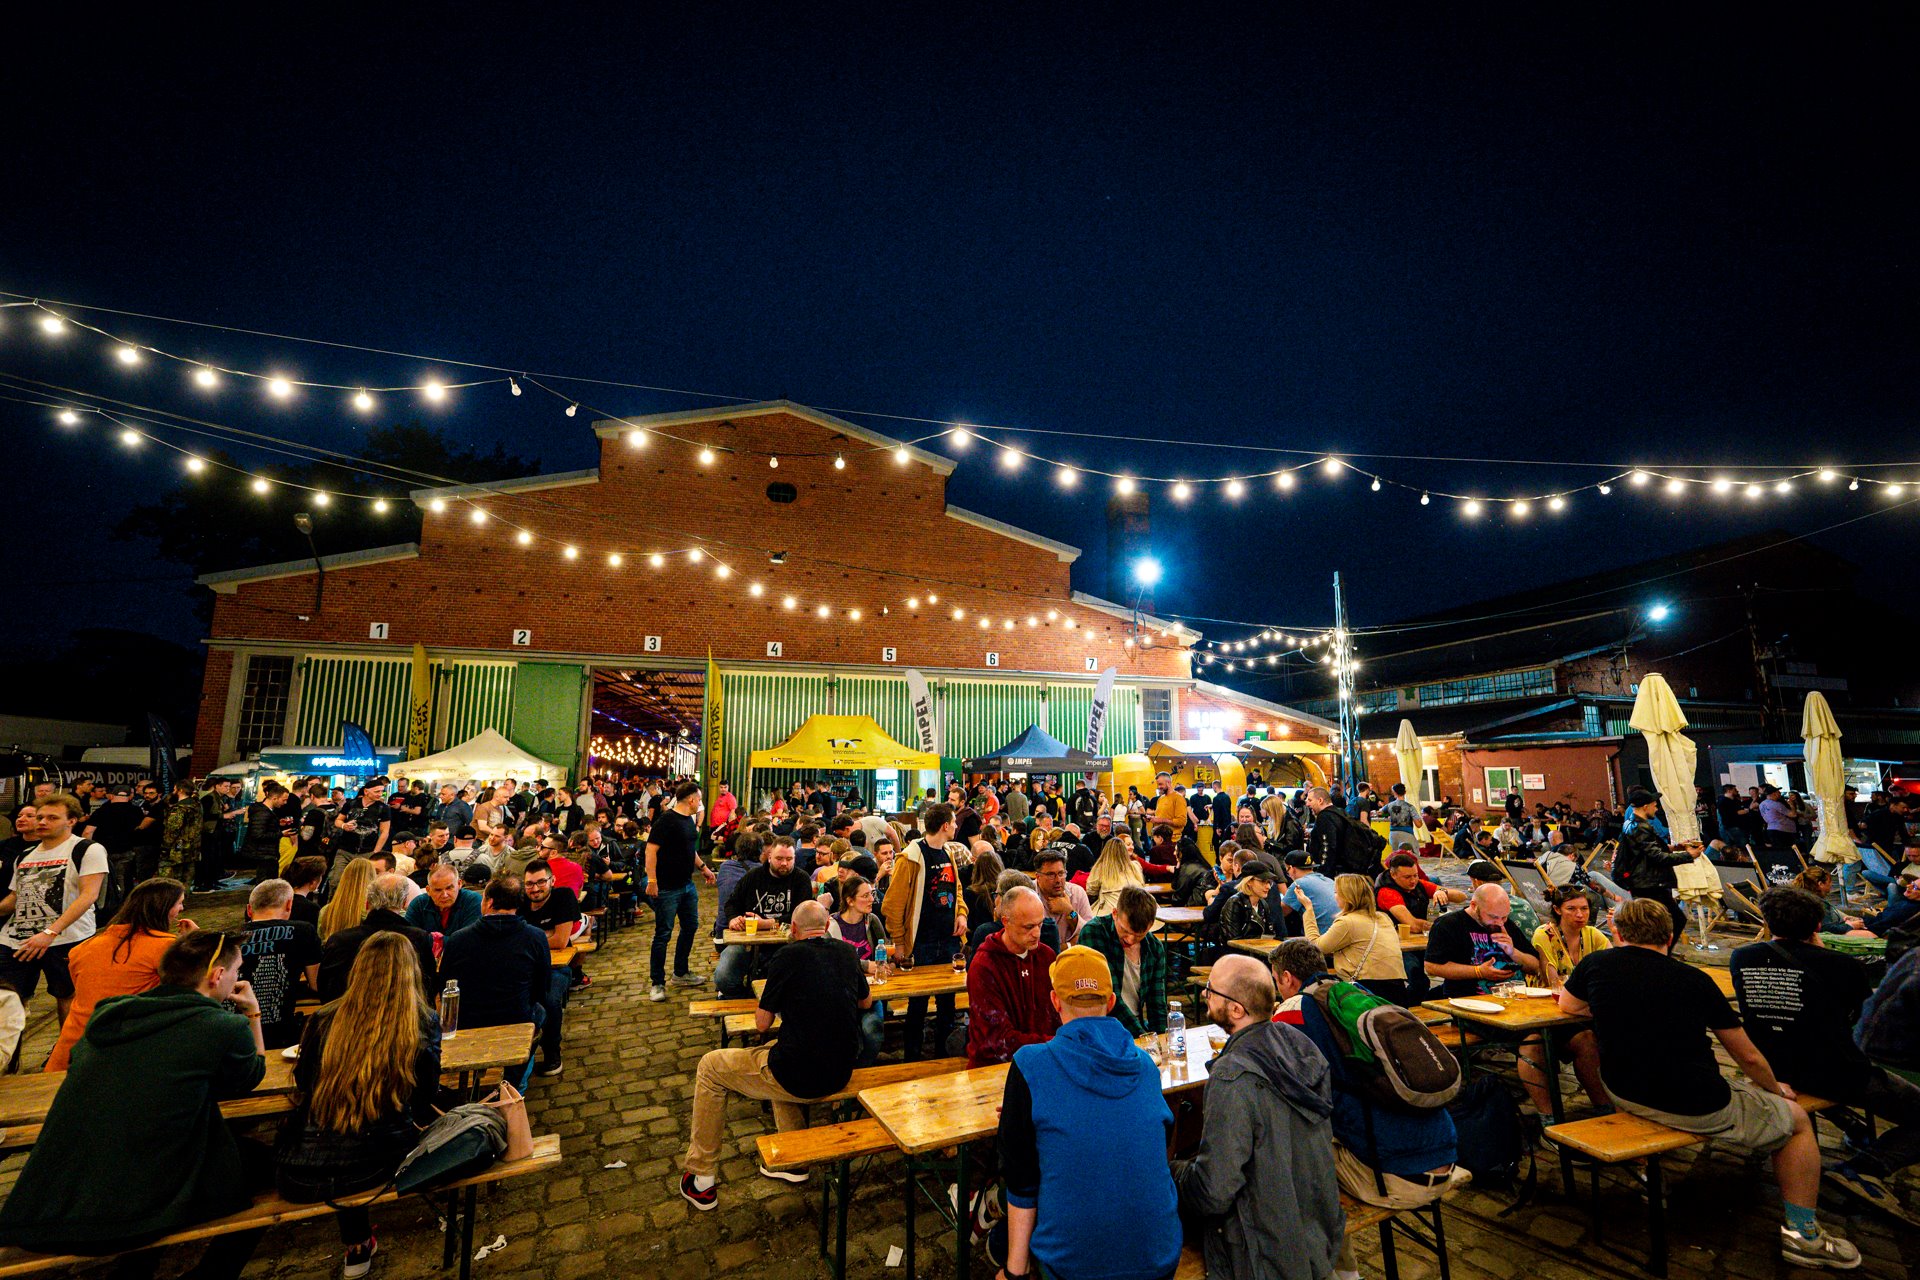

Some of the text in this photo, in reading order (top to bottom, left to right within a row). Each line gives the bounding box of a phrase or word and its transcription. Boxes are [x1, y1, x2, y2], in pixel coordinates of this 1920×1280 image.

[375, 623, 384, 637] 1
[518, 631, 528, 644] 2
[649, 637, 657, 650] 3
[771, 643, 780, 656] 4
[885, 648, 894, 661] 5
[989, 653, 997, 666] 6
[1088, 658, 1096, 670] 7
[1014, 757, 1033, 765] IMPEL
[64, 770, 106, 785] WODA
[107, 771, 126, 785] DO
[240, 941, 275, 956] OUR
[1075, 978, 1098, 990] BULLS
